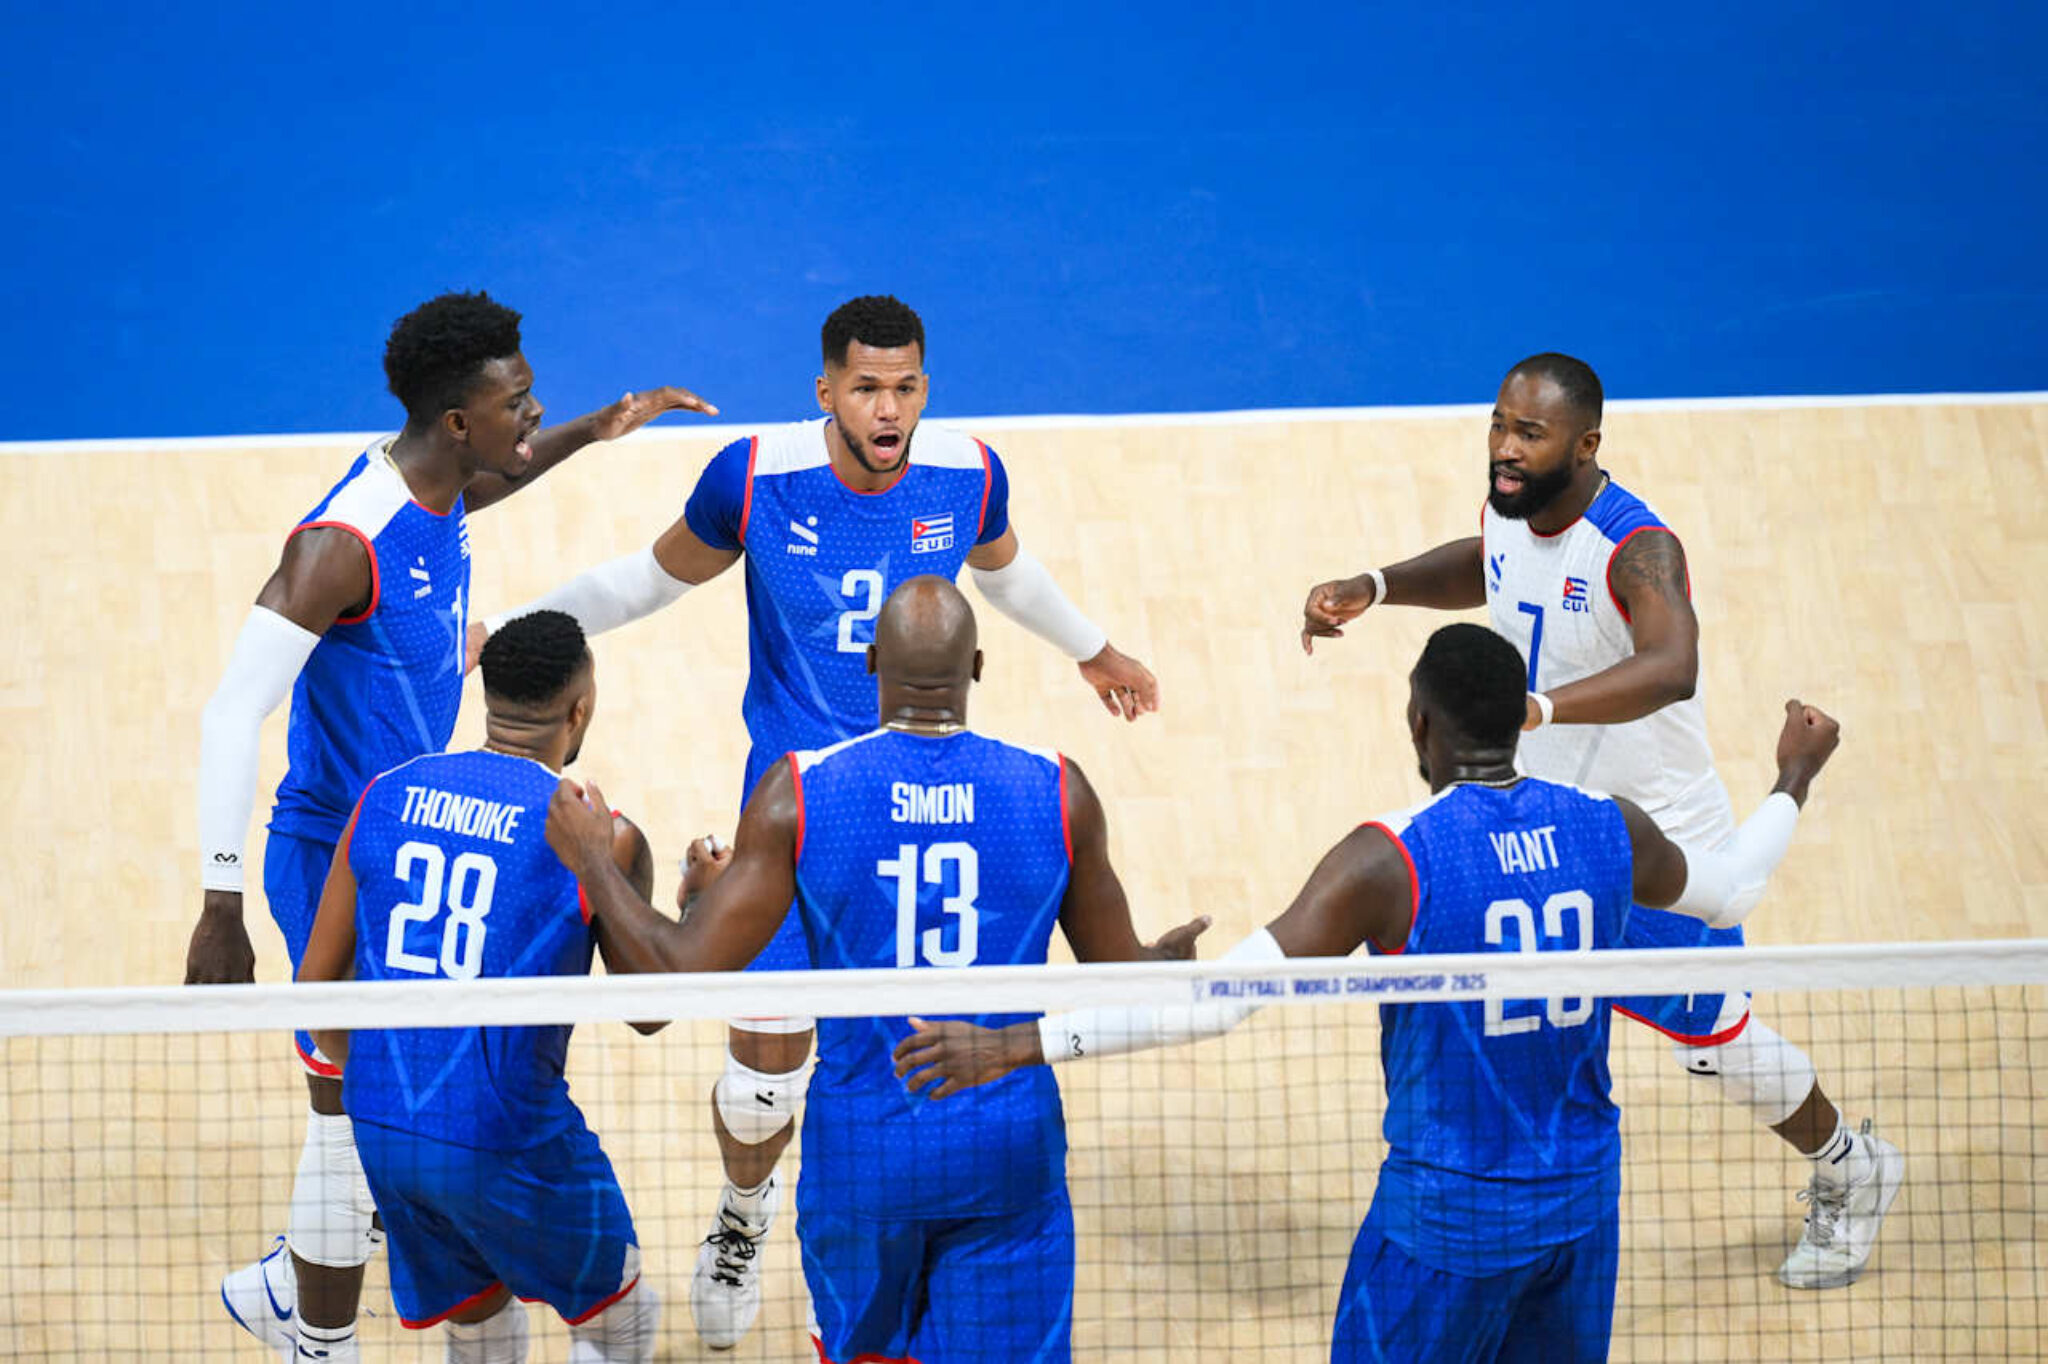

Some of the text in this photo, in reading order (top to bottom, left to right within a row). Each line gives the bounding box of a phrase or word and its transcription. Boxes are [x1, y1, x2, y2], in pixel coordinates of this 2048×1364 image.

[787, 543, 818, 556] nine
[913, 537, 952, 552] CUB
[837, 569, 883, 653] 2
[1518, 601, 1544, 693] 7
[401, 786, 525, 844] THONDIKE
[891, 782, 974, 824] SIMON
[1489, 825, 1560, 875] YANT
[385, 841, 498, 979] 28
[877, 842, 979, 968] 13
[1210, 973, 1486, 997] VOLLEYBALL WORLD CHAMPIONSHIP 2025
